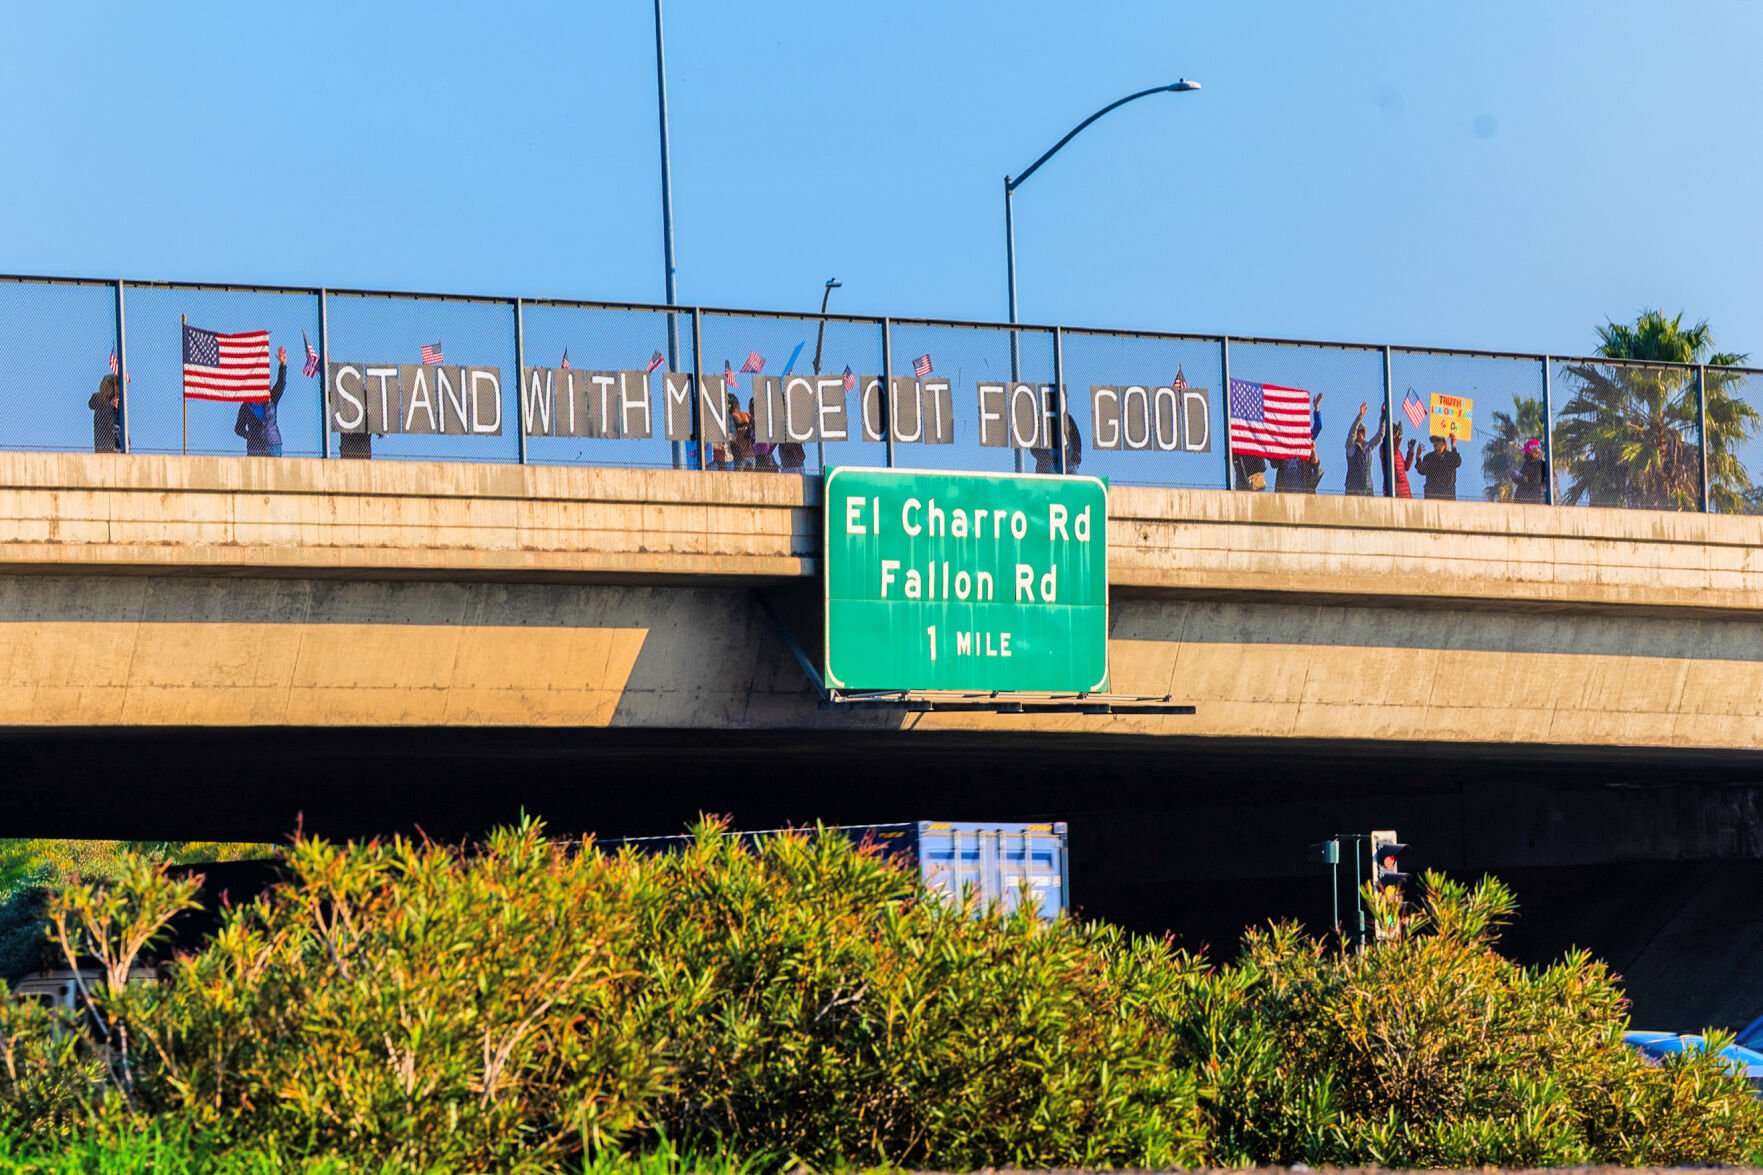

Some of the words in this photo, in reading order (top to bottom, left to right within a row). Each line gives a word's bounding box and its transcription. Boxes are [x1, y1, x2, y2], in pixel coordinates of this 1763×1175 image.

[334, 365, 501, 433] STAND
[523, 370, 651, 434] WITH
[666, 377, 728, 439] MN
[766, 377, 848, 441] ICE
[862, 379, 948, 442] OUT
[979, 384, 1068, 448] FOR
[1094, 386, 1210, 451] GOOD
[845, 496, 880, 535] El
[901, 497, 1028, 540] Charro
[1049, 503, 1091, 542] Rd
[880, 560, 994, 601] Fallon
[1015, 564, 1057, 603] Rd
[927, 625, 937, 661] 1
[956, 631, 1012, 657] MILE
